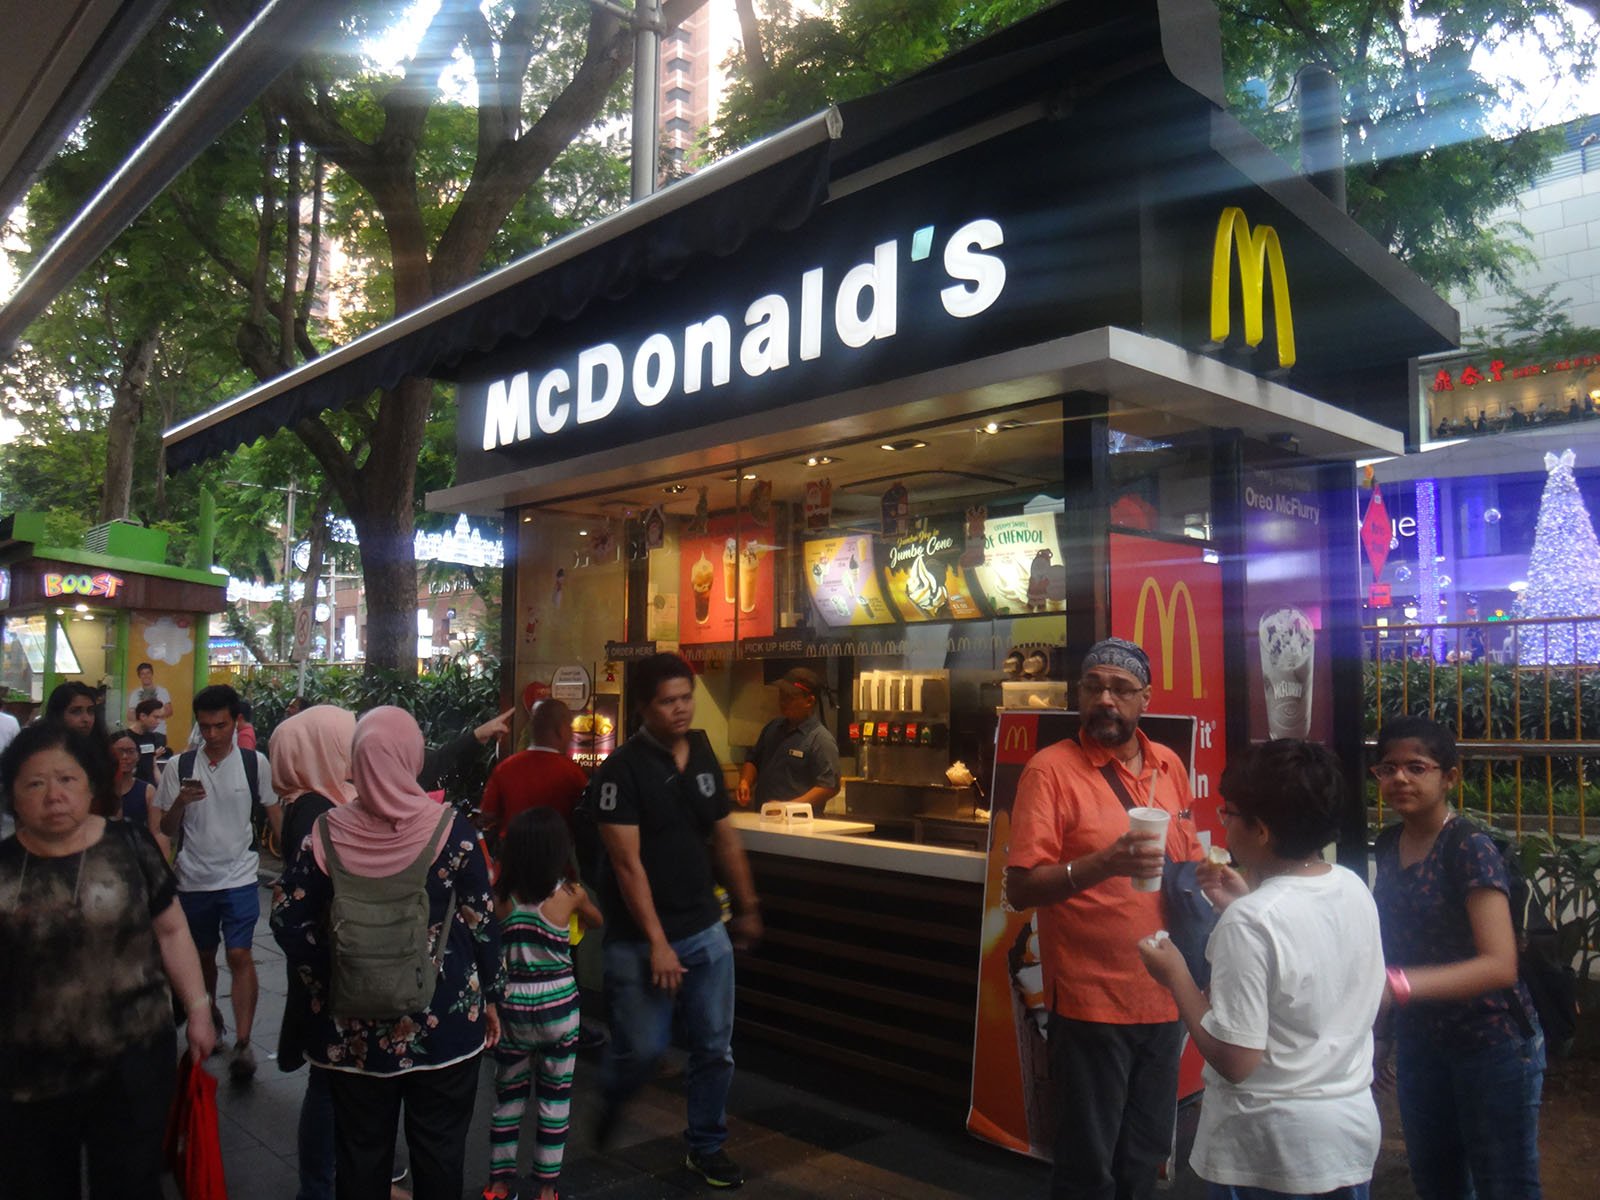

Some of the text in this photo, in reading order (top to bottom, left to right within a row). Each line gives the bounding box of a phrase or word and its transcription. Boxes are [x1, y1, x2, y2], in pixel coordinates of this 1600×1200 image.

[482, 218, 1007, 452] McDonald's
[1245, 486, 1320, 526] Oreo McFlurry
[998, 529, 1044, 545] CHENDOL
[889, 536, 954, 569] Jumbo Cone
[44, 573, 123, 598] BOOST
[779, 640, 803, 652] HERE
[599, 782, 618, 811] 8
